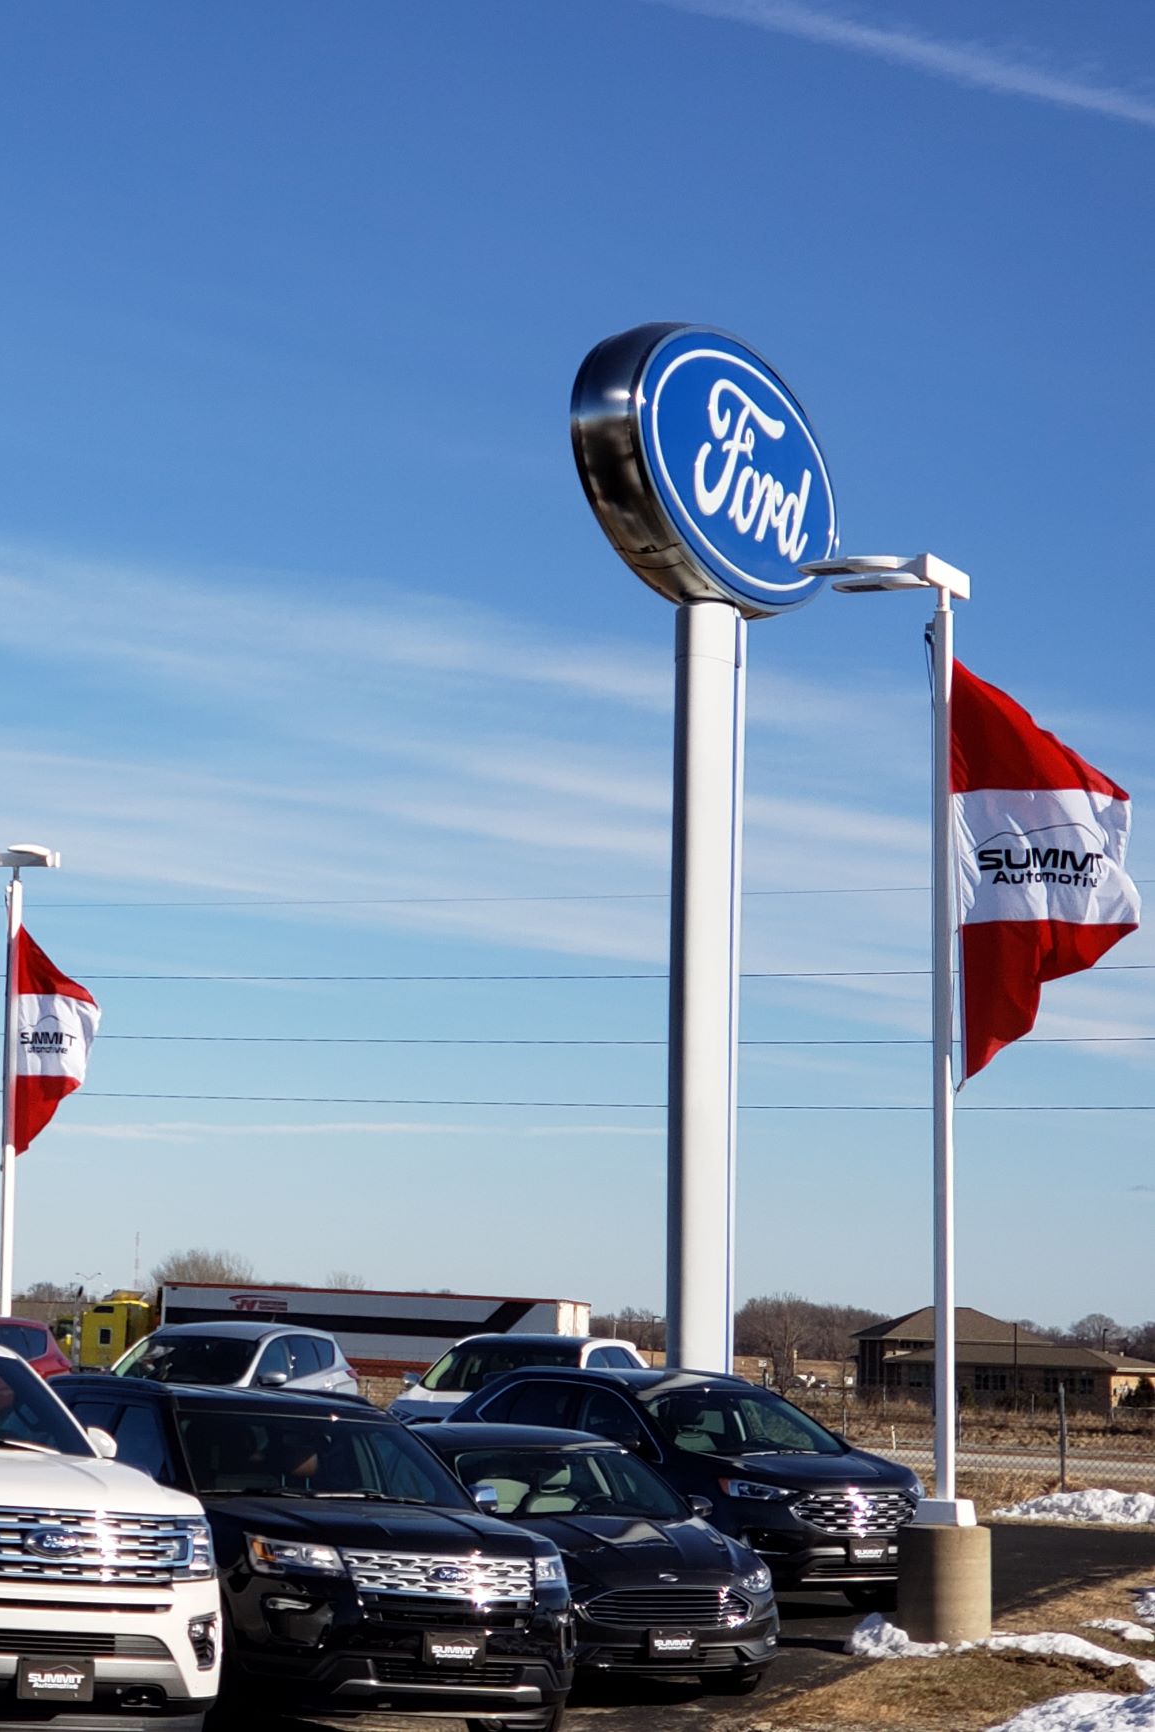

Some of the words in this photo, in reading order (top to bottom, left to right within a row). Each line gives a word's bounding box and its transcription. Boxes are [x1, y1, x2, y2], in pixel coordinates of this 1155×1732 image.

[694, 378, 812, 563] Ford
[978, 847, 1103, 874] SUMMT
[992, 870, 1098, 887] Automotiv
[431, 1645, 479, 1655] SUMMIT
[28, 1673, 85, 1684] SUMMIT
[32, 1681, 79, 1690] Automotive
